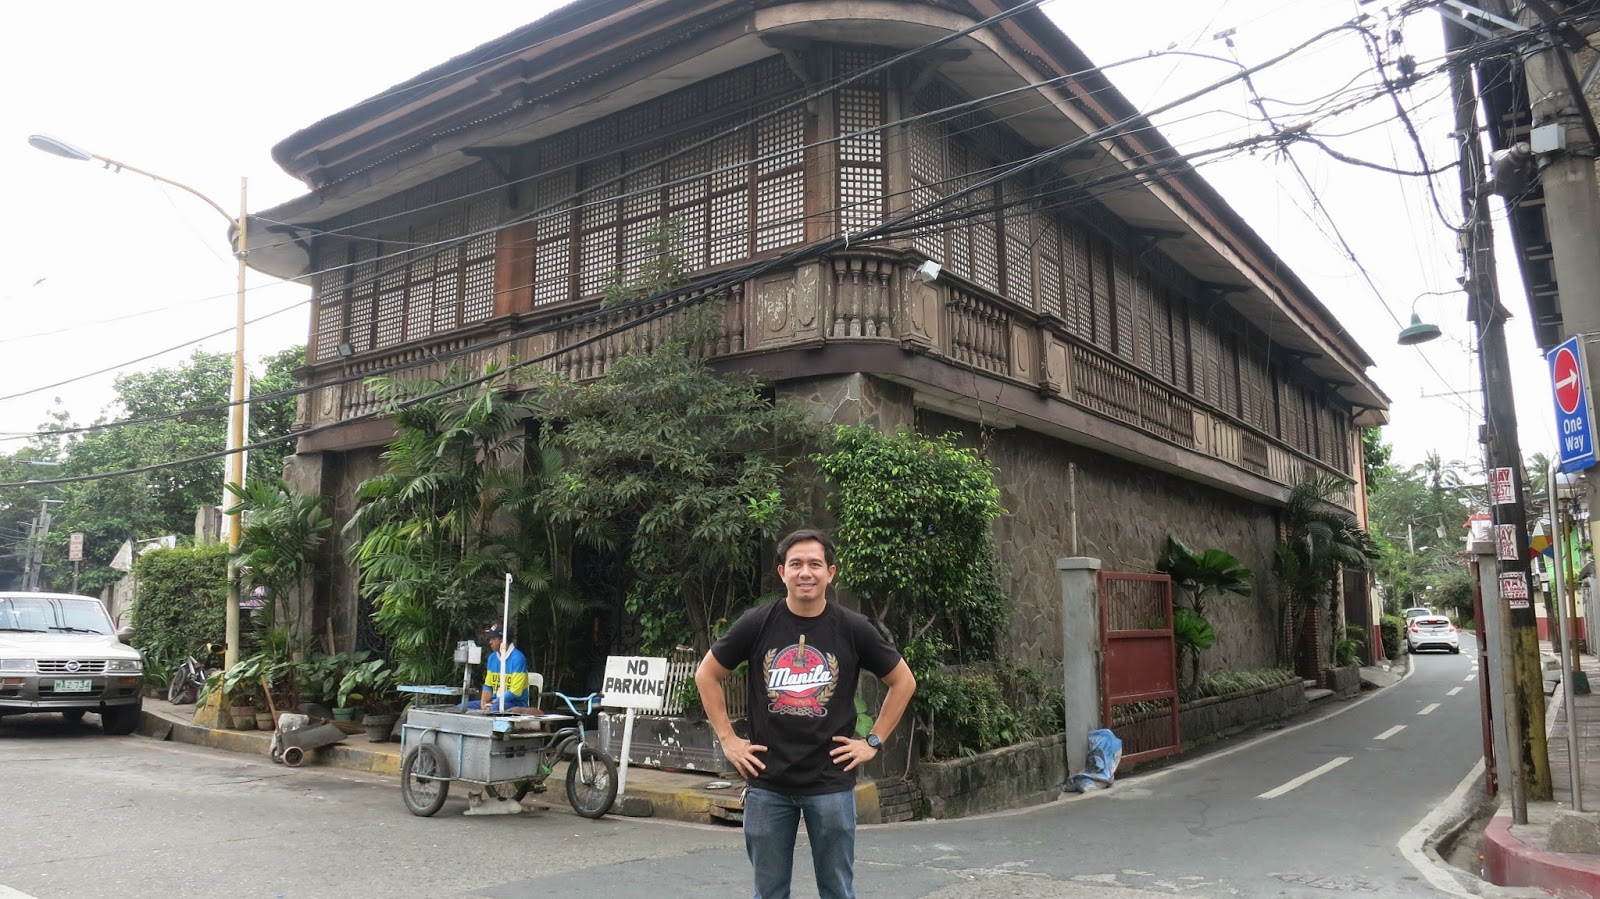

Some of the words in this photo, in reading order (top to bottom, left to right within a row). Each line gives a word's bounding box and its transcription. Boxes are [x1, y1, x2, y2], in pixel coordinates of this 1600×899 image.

[1563, 416, 1583, 435] One
[1564, 434, 1584, 452] Way
[626, 659, 649, 676] NO
[768, 664, 833, 688] Manila
